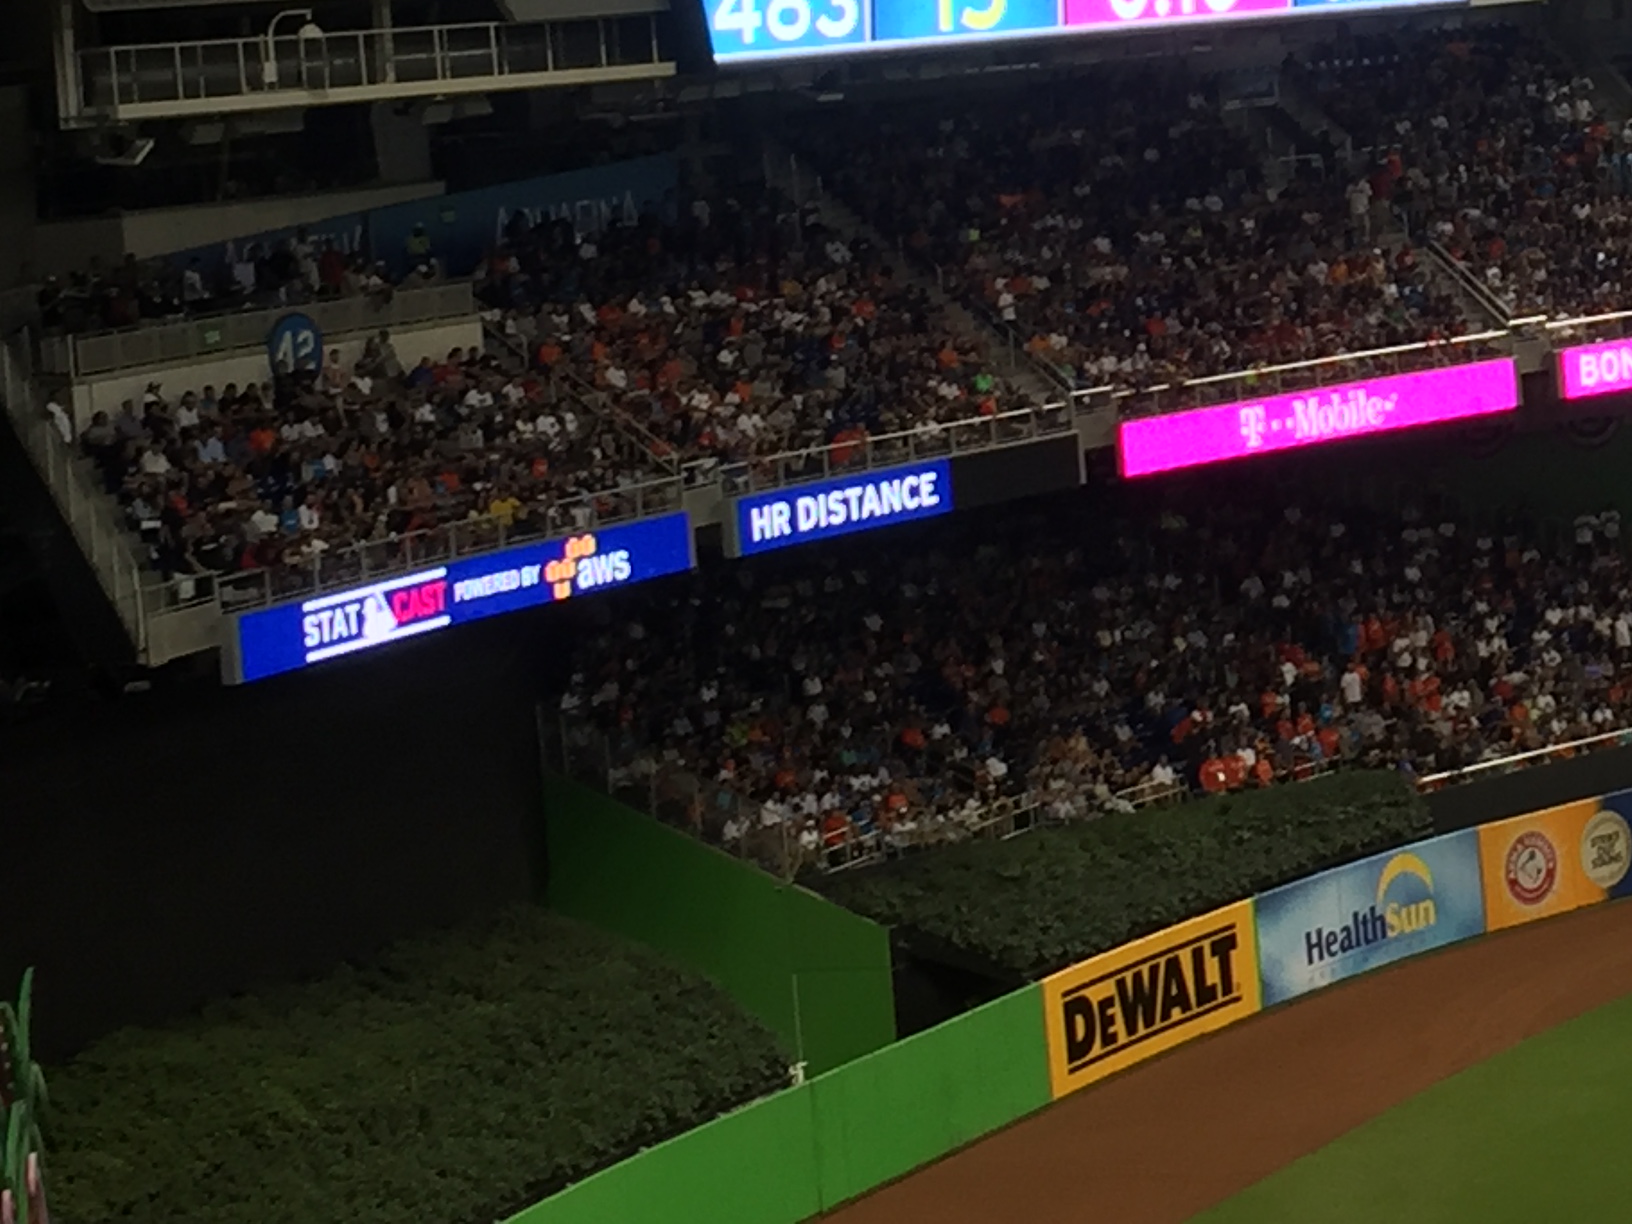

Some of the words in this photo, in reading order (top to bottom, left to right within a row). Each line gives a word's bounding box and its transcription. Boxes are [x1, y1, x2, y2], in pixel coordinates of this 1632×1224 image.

[750, 498, 792, 542] HR
[797, 471, 941, 533] DISTANCE
[453, 569, 521, 603] POWERED
[521, 563, 542, 588] BY
[577, 549, 632, 590] aws
[303, 603, 361, 647] STAT
[393, 581, 446, 622] CAST
[1305, 897, 1437, 967] HealthSun
